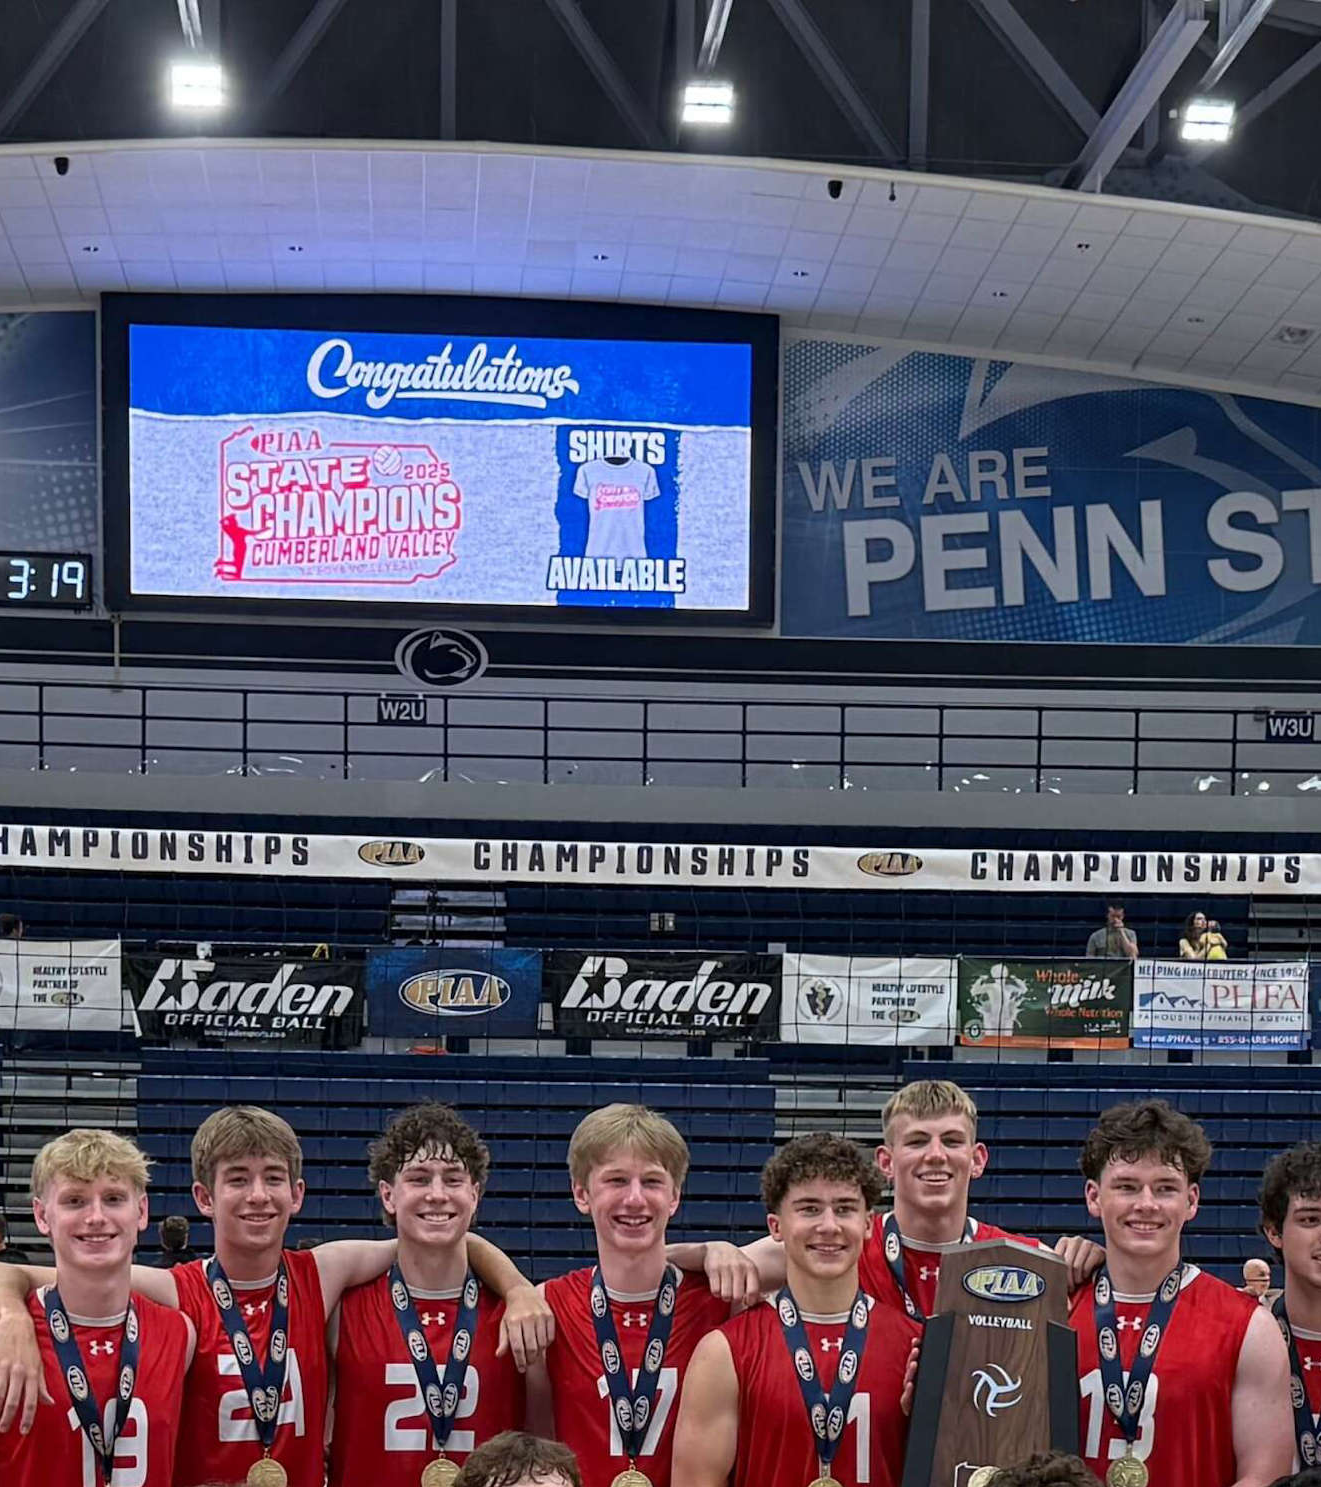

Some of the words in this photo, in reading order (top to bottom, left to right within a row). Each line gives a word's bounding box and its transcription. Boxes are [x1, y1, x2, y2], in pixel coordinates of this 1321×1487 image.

[306, 338, 579, 409] Congratulations
[261, 431, 323, 452] PIAA
[569, 430, 666, 464] SHIRTS
[227, 456, 370, 508] STATE
[404, 462, 451, 480] 2025
[798, 457, 898, 512] WE
[923, 447, 1052, 505] ARE
[253, 481, 461, 541] CHAMPIONS
[251, 535, 379, 567] CUMBERLAND
[386, 532, 456, 558] VALLEY
[842, 499, 1168, 617] PENN
[7, 559, 85, 600] 3:19
[547, 555, 686, 593] AVAILABLE
[379, 699, 426, 722] W2U
[1268, 715, 1313, 739] W3U
[366, 842, 423, 864] PIAA
[474, 842, 809, 878] CHAMPIONSHIPS
[864, 853, 919, 874] PIAA
[971, 852, 1300, 884] CHAMPIONSHIPS
[138, 959, 355, 1017] Baden
[414, 976, 505, 1006] PIAA
[561, 956, 773, 1016] Baden
[1033, 968, 1080, 984] Whole
[1212, 983, 1302, 1010] PHFA
[164, 1012, 261, 1028] OFFICIAL
[273, 1015, 328, 1030] BALL
[586, 1010, 680, 1026] OFFICIAL
[694, 1013, 748, 1028] BALL
[971, 1270, 1042, 1297] PIAA
[967, 1313, 1034, 1331] VOLLEYBALL
[384, 1363, 480, 1452] 22
